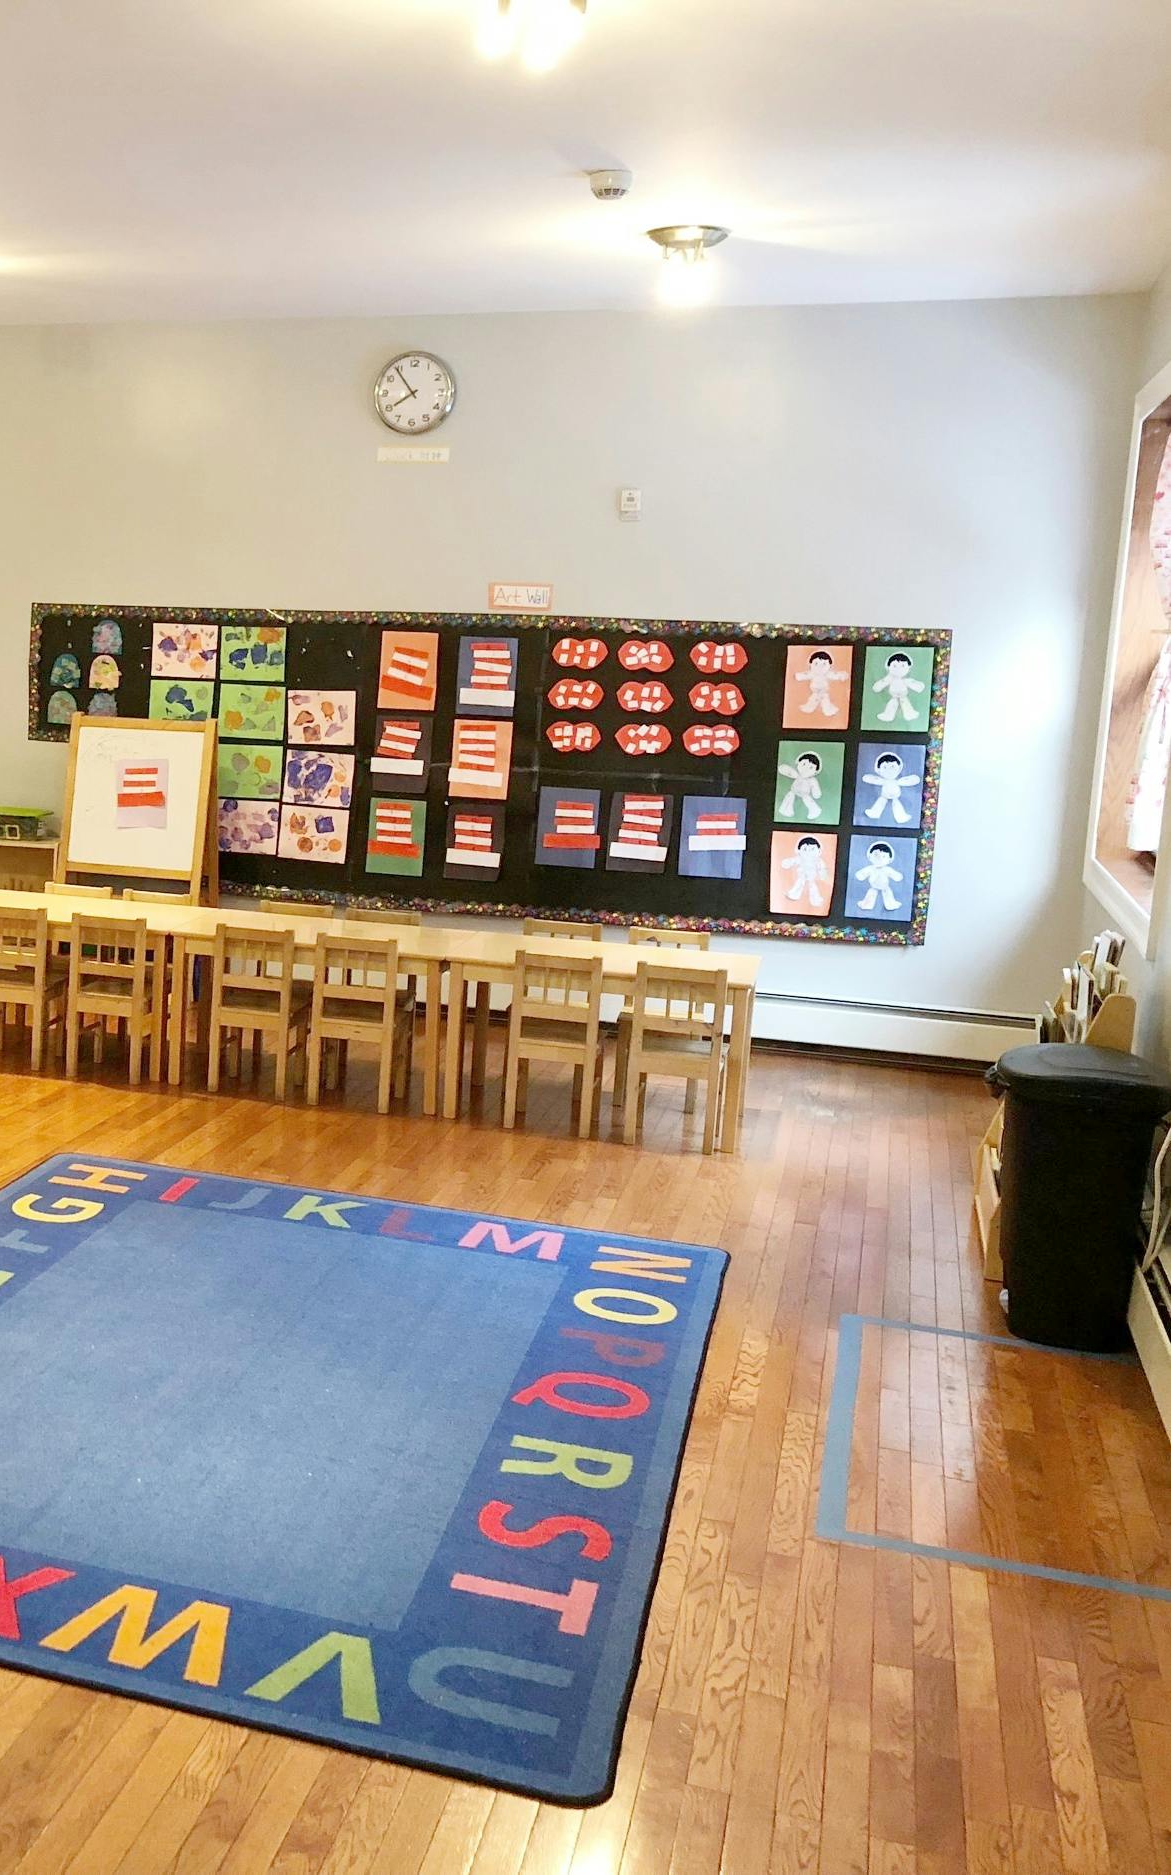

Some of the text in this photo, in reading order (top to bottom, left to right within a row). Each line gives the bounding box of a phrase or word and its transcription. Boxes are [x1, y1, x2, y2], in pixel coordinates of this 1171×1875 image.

[494, 587, 521, 603] Art
[10, 1192, 106, 1224] G
[283, 1195, 367, 1229] K
[458, 1221, 565, 1262] M
[572, 1287, 679, 1326] O
[510, 1371, 652, 1420] Q
[499, 1434, 634, 1490] R
[477, 1500, 613, 1562] S
[449, 1572, 600, 1638] T
[38, 1583, 232, 1687] W
[242, 1630, 382, 1726] V
